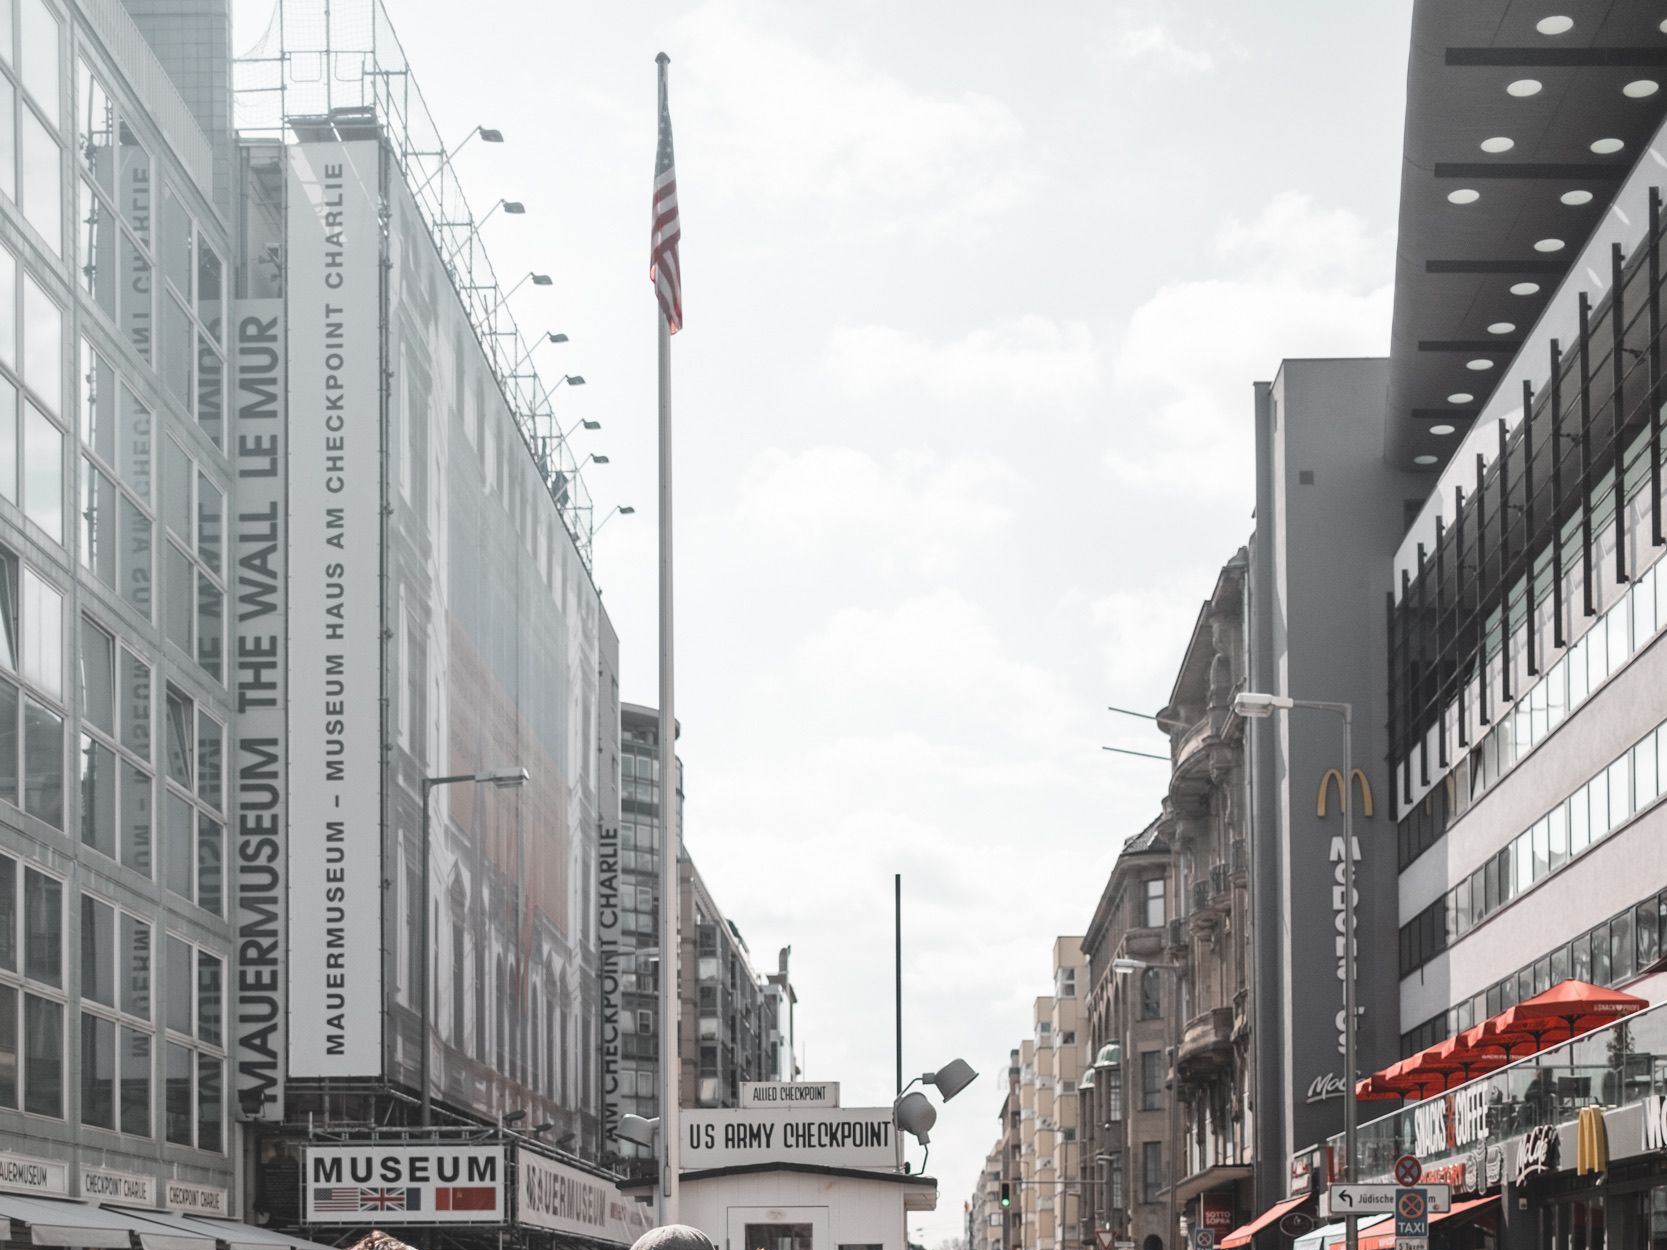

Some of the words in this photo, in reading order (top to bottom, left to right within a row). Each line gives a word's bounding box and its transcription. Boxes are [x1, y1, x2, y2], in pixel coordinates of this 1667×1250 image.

[324, 163, 344, 289] CHARLIE
[238, 316, 279, 419] MUR
[325, 304, 345, 493] CHECKPOINT
[238, 434, 278, 478] LE
[238, 502, 278, 623] WALL
[325, 508, 345, 550] AM
[325, 563, 345, 640] HAUS
[238, 636, 278, 714] THE
[325, 654, 345, 780] MUSEUM
[599, 827, 618, 931] CHARLIE
[238, 738, 280, 1102] MAUERMUSEUM
[325, 821, 345, 1055] MAUERMUSEUM
[601, 938, 619, 1095] CHECKPOINT
[753, 1087, 777, 1101] ALLIED
[780, 1086, 827, 1101] CHECKPOINT
[1415, 1098, 1446, 1157] SNACKS
[1455, 1079, 1489, 1146] COFFEE
[313, 1156, 496, 1183] MUSEUM
[725, 1122, 774, 1149] ARMY
[783, 1121, 891, 1148] CHECKPOINT
[85, 1173, 122, 1195] CHECKPOINT
[124, 1178, 147, 1200] CHARLIE
[169, 1186, 199, 1206] CHECKPOINT
[201, 1191, 220, 1209] CHARLIE
[526, 1163, 606, 1228] MAUERMUSEUM
[1398, 1222, 1425, 1233] TAXI
